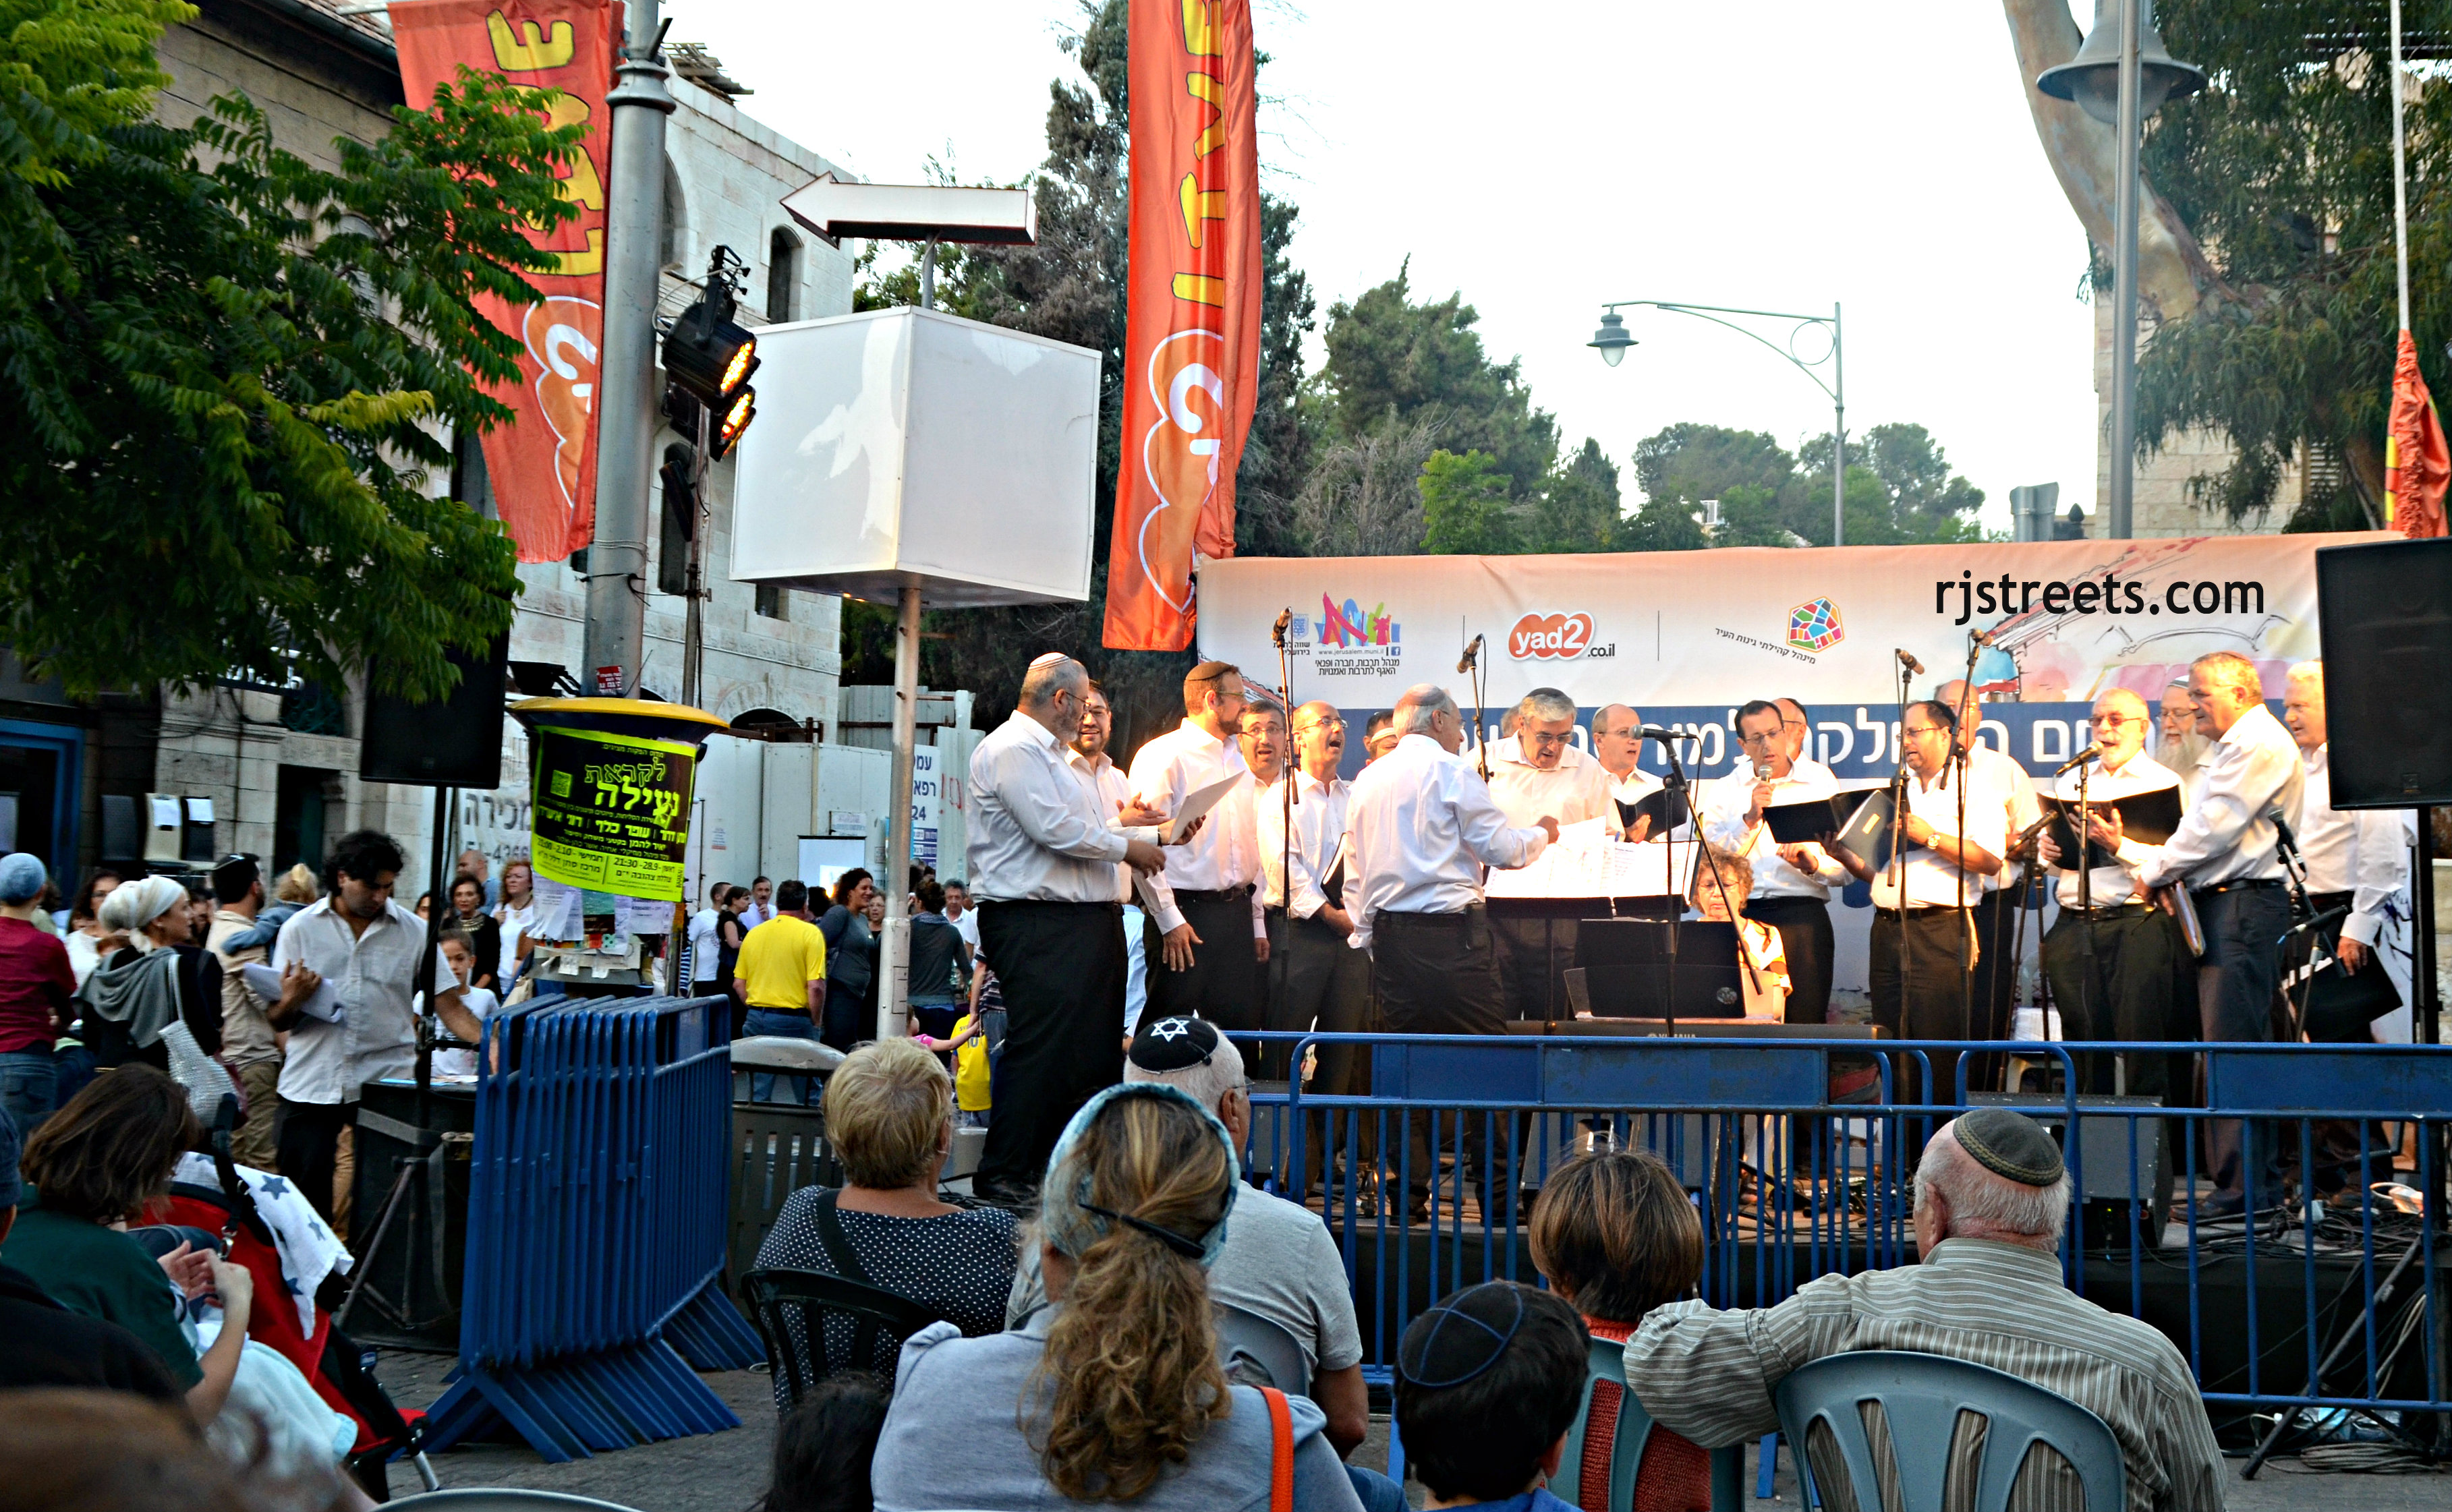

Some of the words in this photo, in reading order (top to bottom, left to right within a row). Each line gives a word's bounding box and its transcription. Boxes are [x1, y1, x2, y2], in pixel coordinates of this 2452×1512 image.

[1516, 619, 1585, 655] yad2
[1715, 628, 1735, 639] העיר
[1736, 634, 1757, 646] גינות
[1319, 647, 1384, 656] www.jerusalem.muni.il
[1759, 641, 1790, 656] קהילתי
[1381, 657, 1400, 666] מנהל
[1792, 649, 1816, 664] מינהל
[1315, 659, 1333, 668] ופנאי
[1335, 659, 1354, 667] חברה
[1348, 666, 1375, 675] לתרבות
[1376, 667, 1396, 677] האגף
[913, 755, 932, 771] עמ
[584, 756, 666, 788] לקראת
[595, 775, 680, 817] נעילה
[614, 857, 637, 868] 21:30
[631, 872, 655, 880] צהובה
